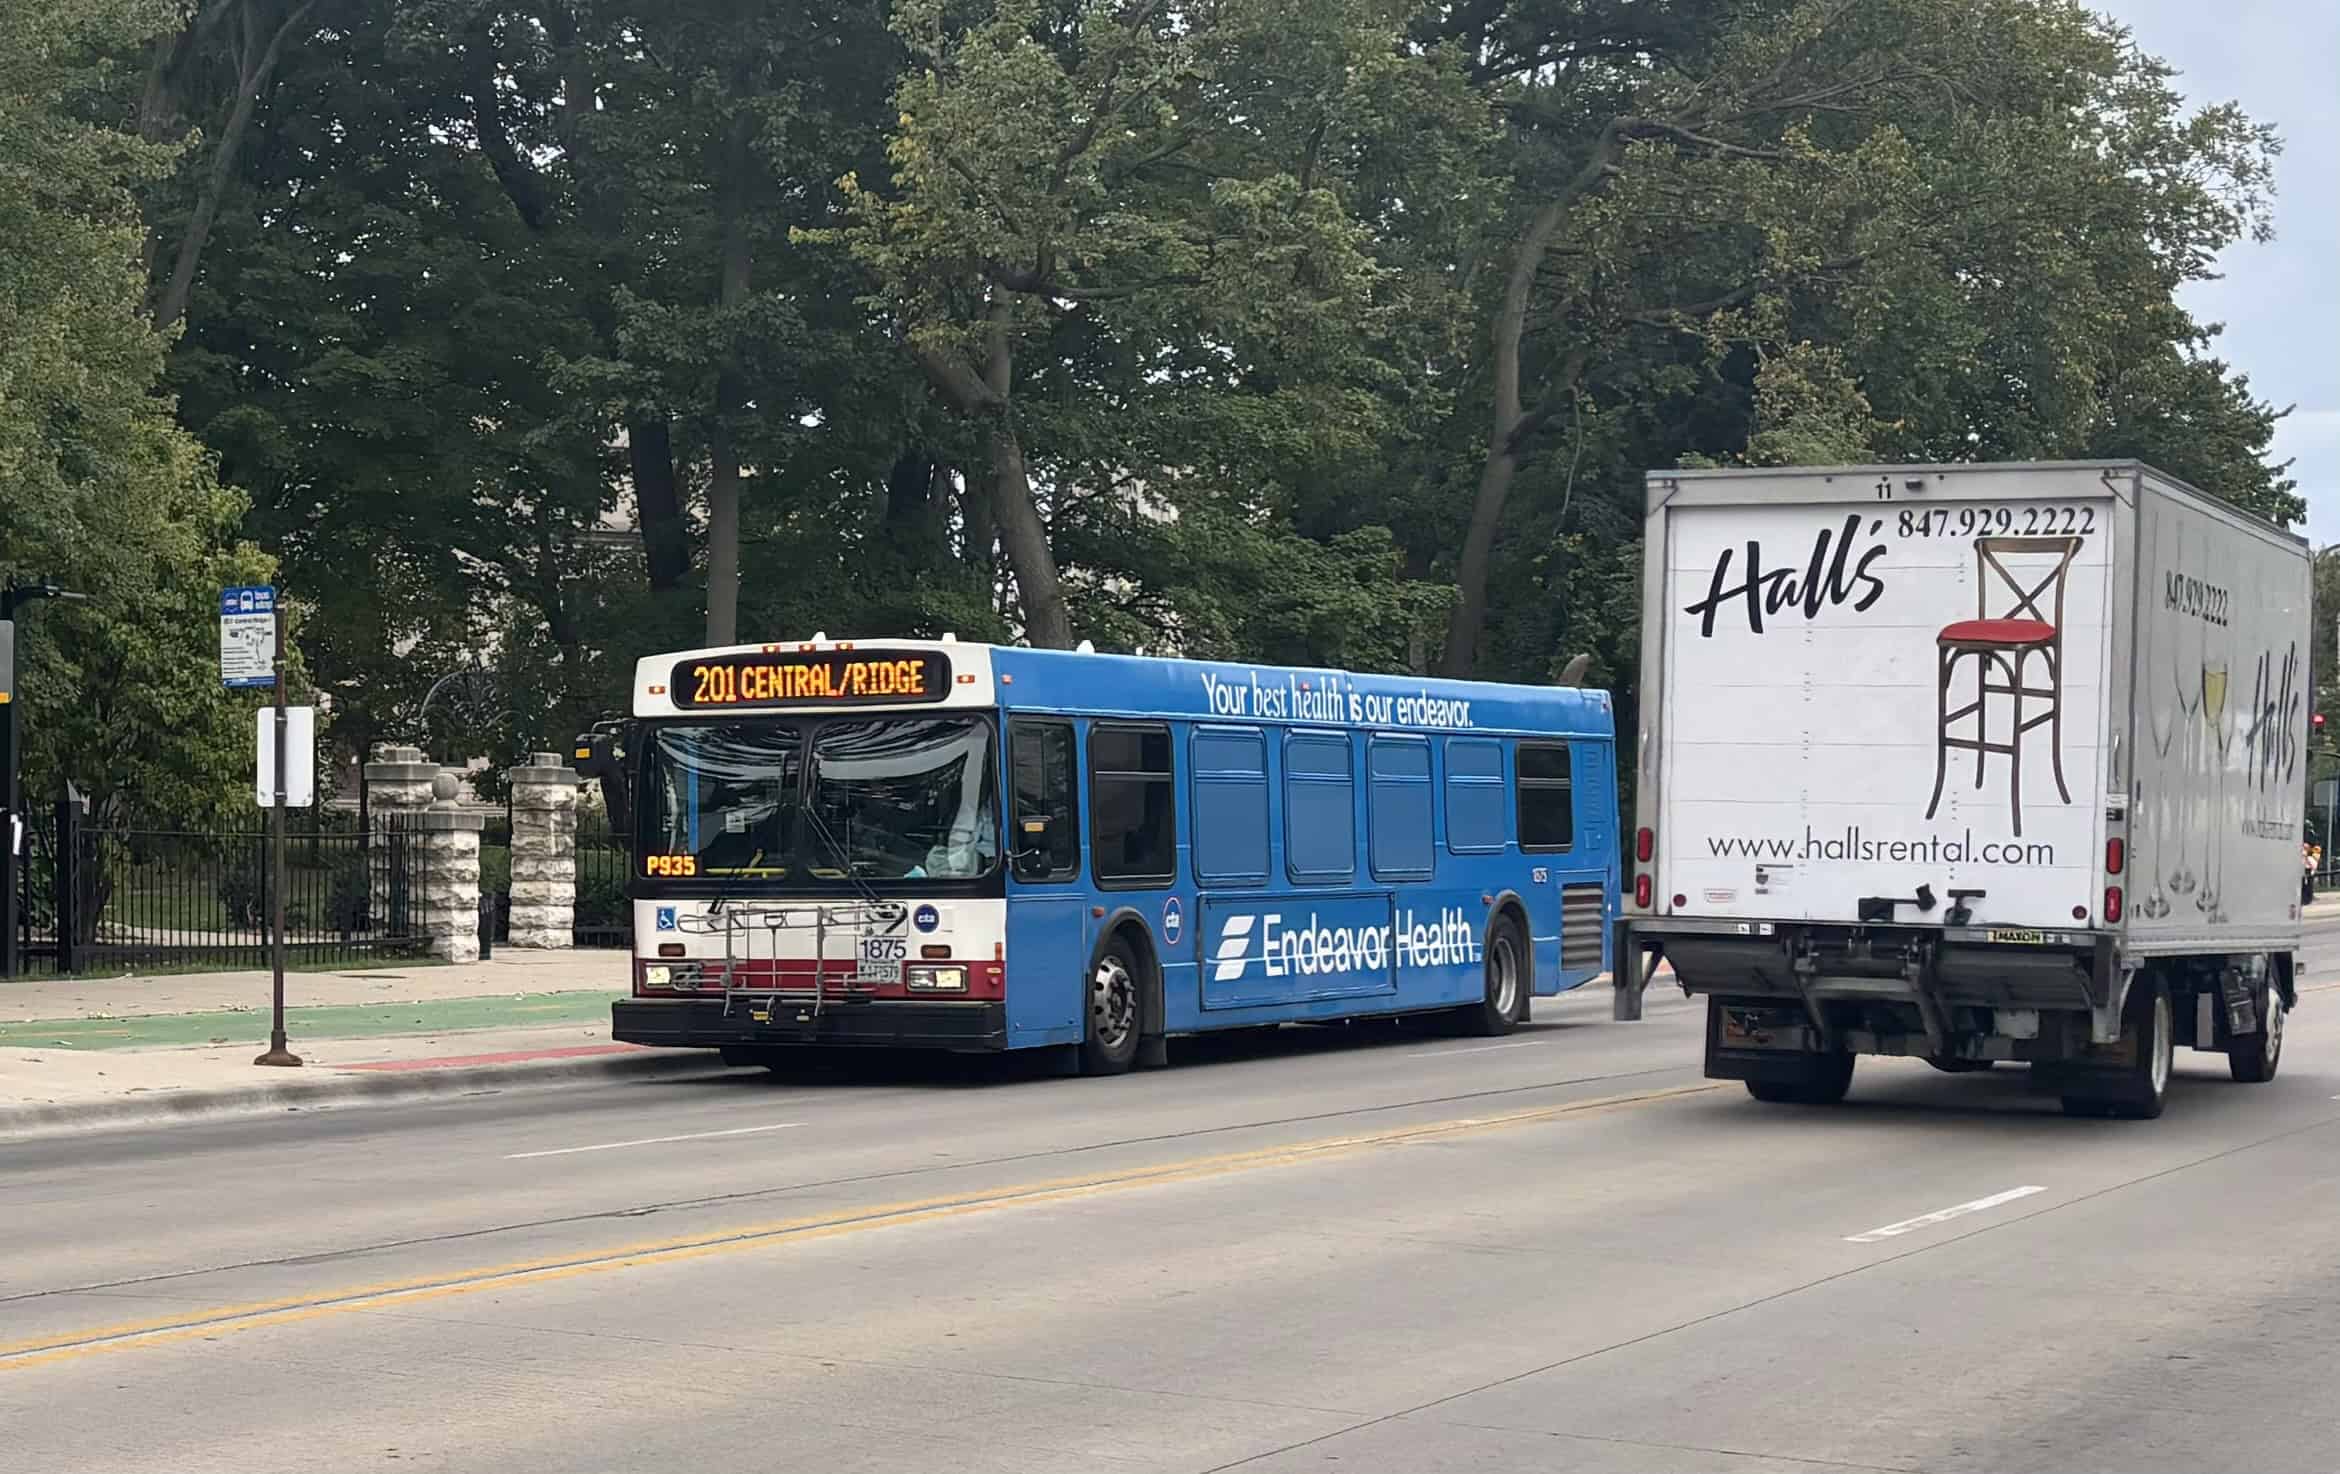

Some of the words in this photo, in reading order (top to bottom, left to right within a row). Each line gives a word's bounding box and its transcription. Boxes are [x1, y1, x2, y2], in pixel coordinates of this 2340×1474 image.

[1875, 482, 1892, 500] 11
[1898, 507, 2096, 538] 847.929.2222
[1683, 514, 1888, 638] Hall's
[693, 664, 737, 703] 201
[740, 659, 925, 699] CENTRAL/RIDGE
[1201, 672, 1248, 715] Your
[1250, 671, 1288, 718] best
[1290, 674, 1345, 721] health
[1347, 683, 1363, 722] is
[1365, 693, 1394, 724] our
[1396, 688, 1474, 728] endeavor.
[647, 855, 696, 876] P935
[1708, 825, 2054, 866] www.hallsrental.com
[860, 939, 906, 960] 1875
[1262, 912, 1390, 977] Endeavor
[1395, 906, 1474, 968] Health
